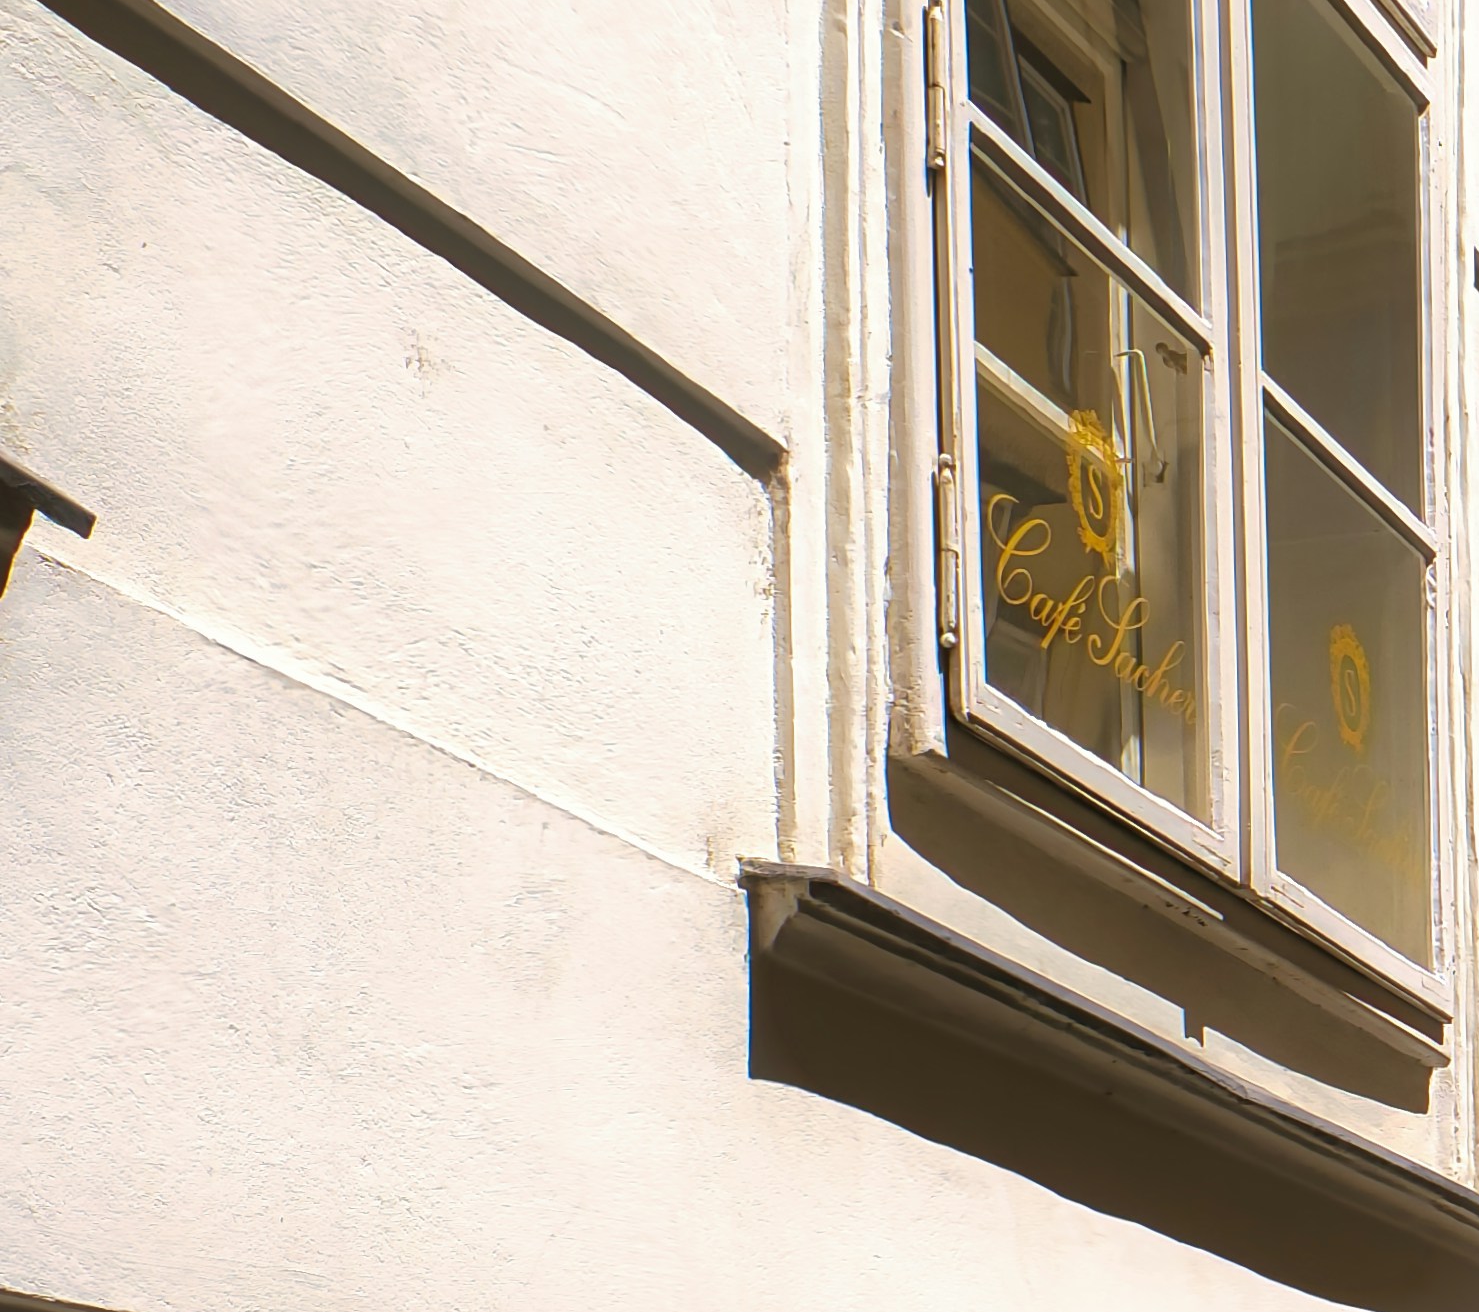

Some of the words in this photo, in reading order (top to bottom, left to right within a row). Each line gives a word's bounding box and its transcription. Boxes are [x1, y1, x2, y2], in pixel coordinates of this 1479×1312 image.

[1088, 466, 1104, 520] S
[987, 494, 1096, 649] Café
[1088, 576, 1197, 726] Sacher
